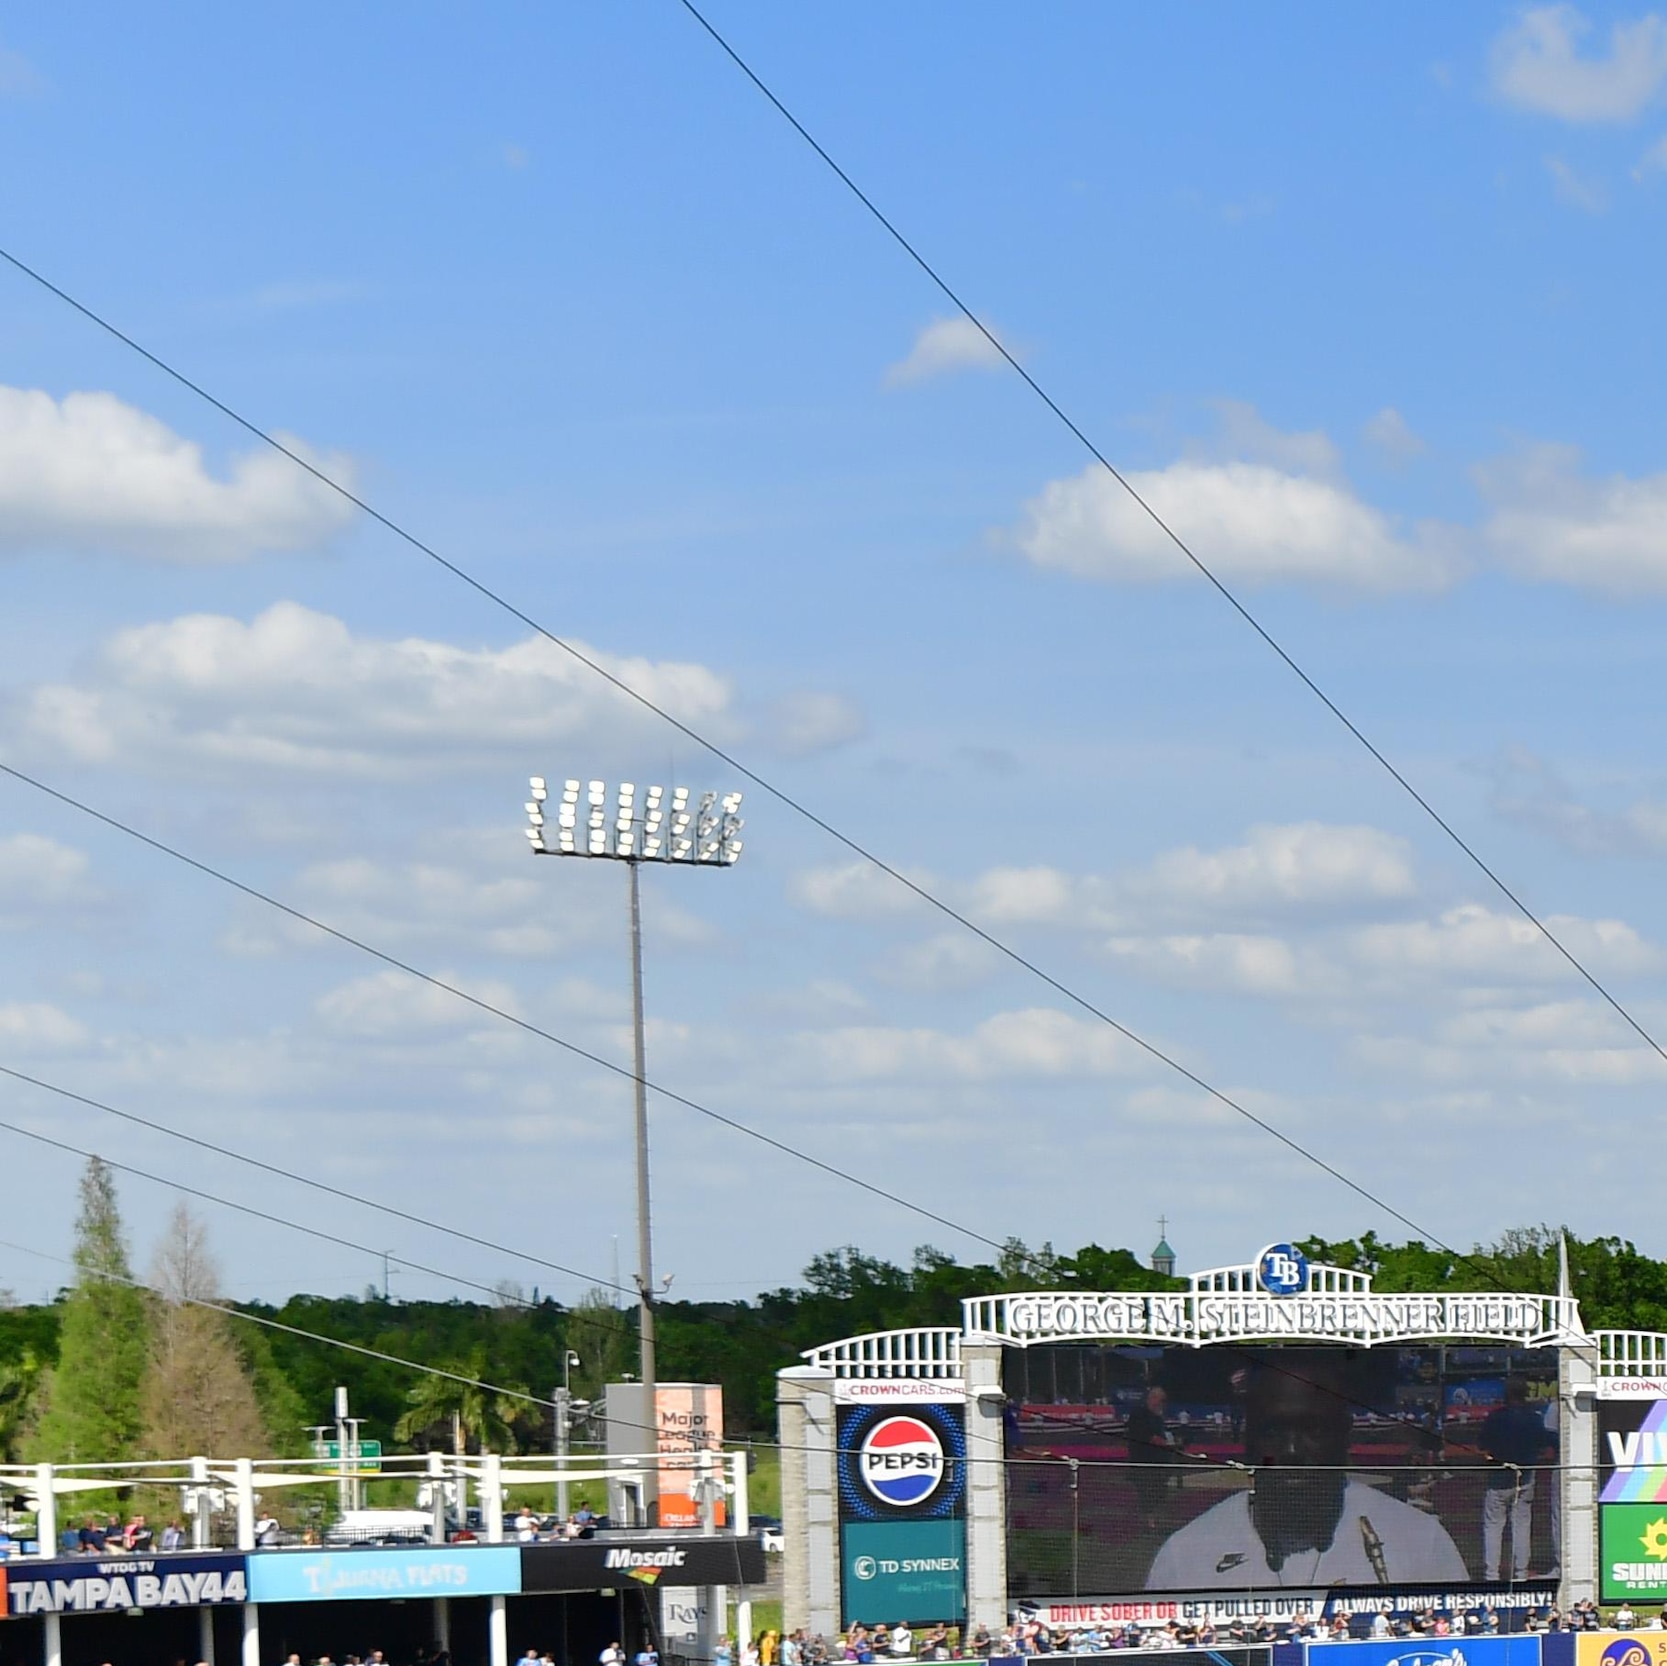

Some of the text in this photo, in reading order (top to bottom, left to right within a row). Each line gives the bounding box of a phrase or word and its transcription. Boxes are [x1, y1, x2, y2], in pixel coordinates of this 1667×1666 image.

[1266, 1254, 1300, 1286] TB
[1011, 1300, 1147, 1334] GEORGE
[1203, 1301, 1444, 1333] STEINBRENNER
[1449, 1301, 1542, 1332] FIELD
[662, 1411, 710, 1427] Major
[868, 1452, 938, 1470] PEPSI
[139, 1561, 156, 1573] TV
[605, 1546, 688, 1568] Mosaic
[878, 1558, 960, 1573] TD SYNNEX
[9, 1576, 135, 1613] TAMPA
[1332, 1591, 1554, 1614] ALWAYS DRIVE RESPONSIBLY!
[669, 1603, 708, 1624] RAYS
[1050, 1596, 1314, 1623] DRIVE SOBER OR GET PULLED OVER
